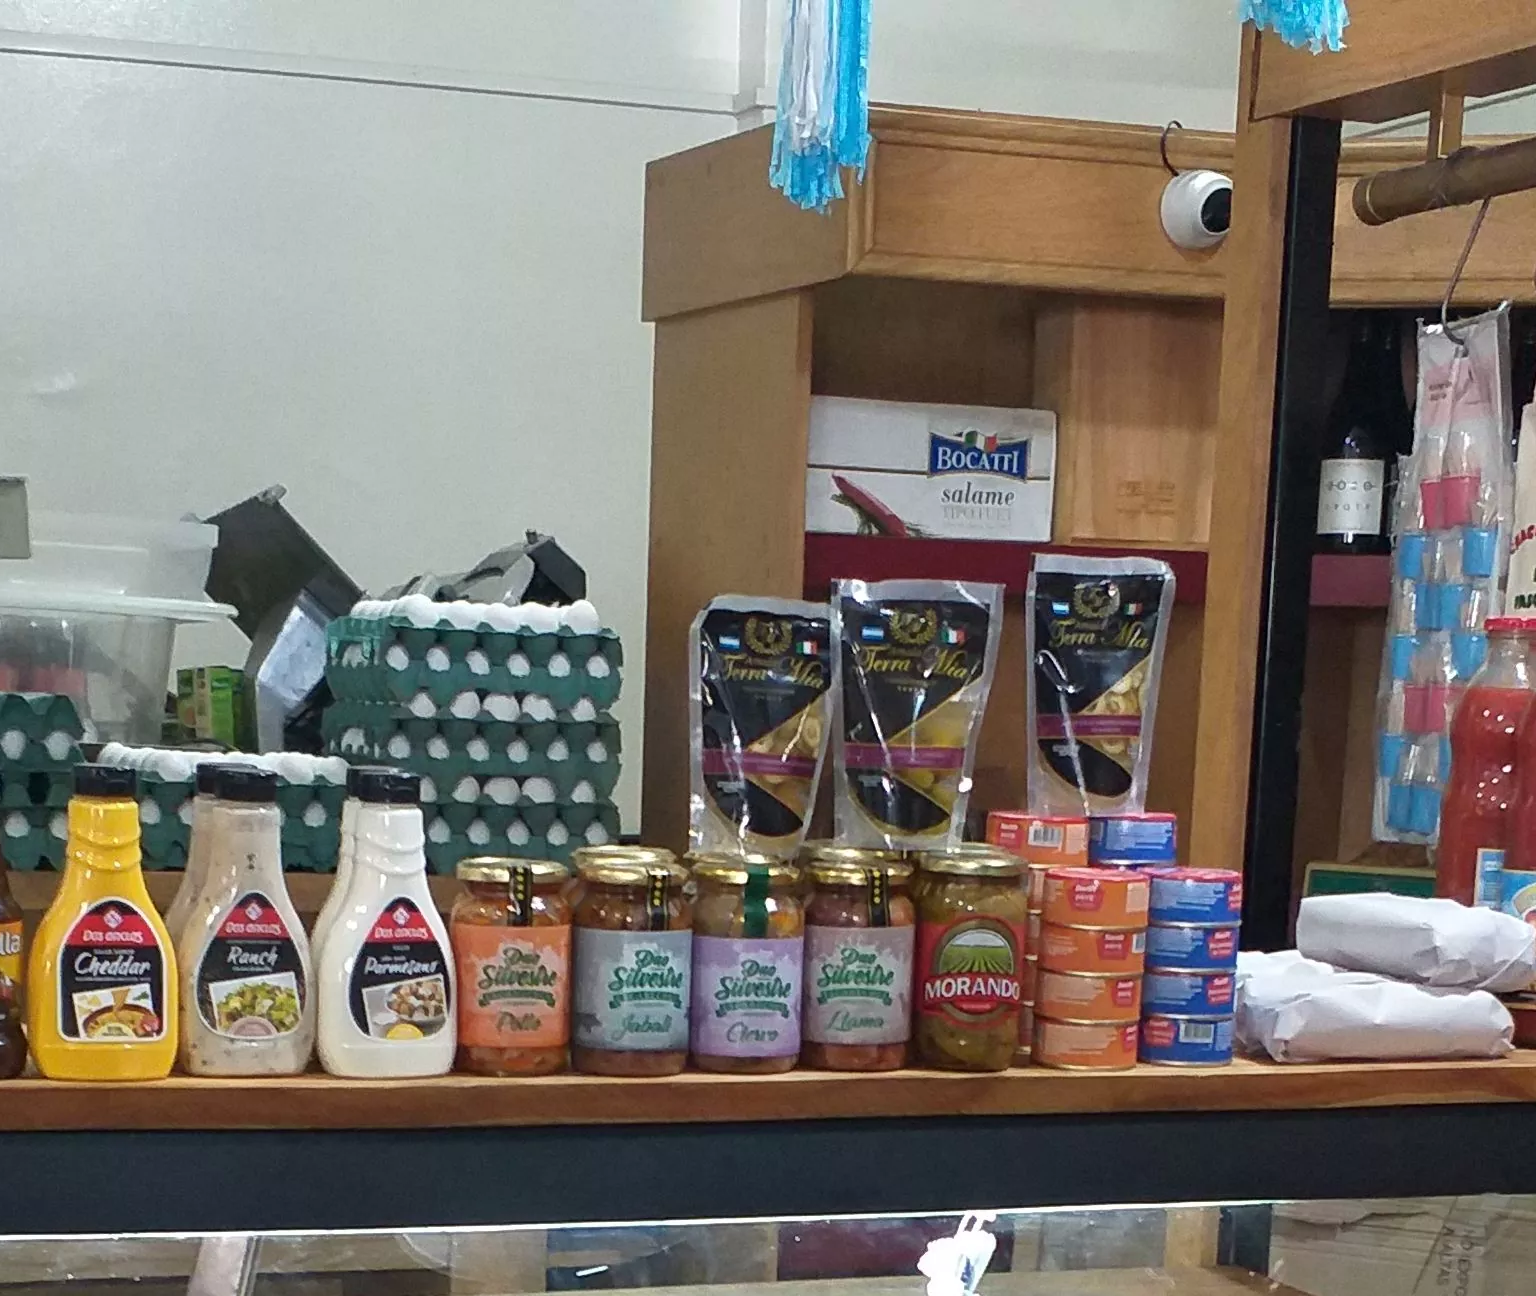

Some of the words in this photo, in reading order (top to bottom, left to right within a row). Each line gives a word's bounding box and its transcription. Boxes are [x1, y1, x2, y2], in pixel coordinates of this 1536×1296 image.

[937, 446, 1019, 474] BOCATTI
[941, 481, 1014, 506] salame
[74, 952, 152, 978] Cheddar
[227, 945, 278, 968] Ranch
[478, 964, 558, 990] Silvestre
[608, 966, 684, 993] Silvestre
[715, 976, 792, 1001] Silvestre
[817, 964, 895, 989] Silvestre
[925, 977, 1021, 1001] MORANDO
